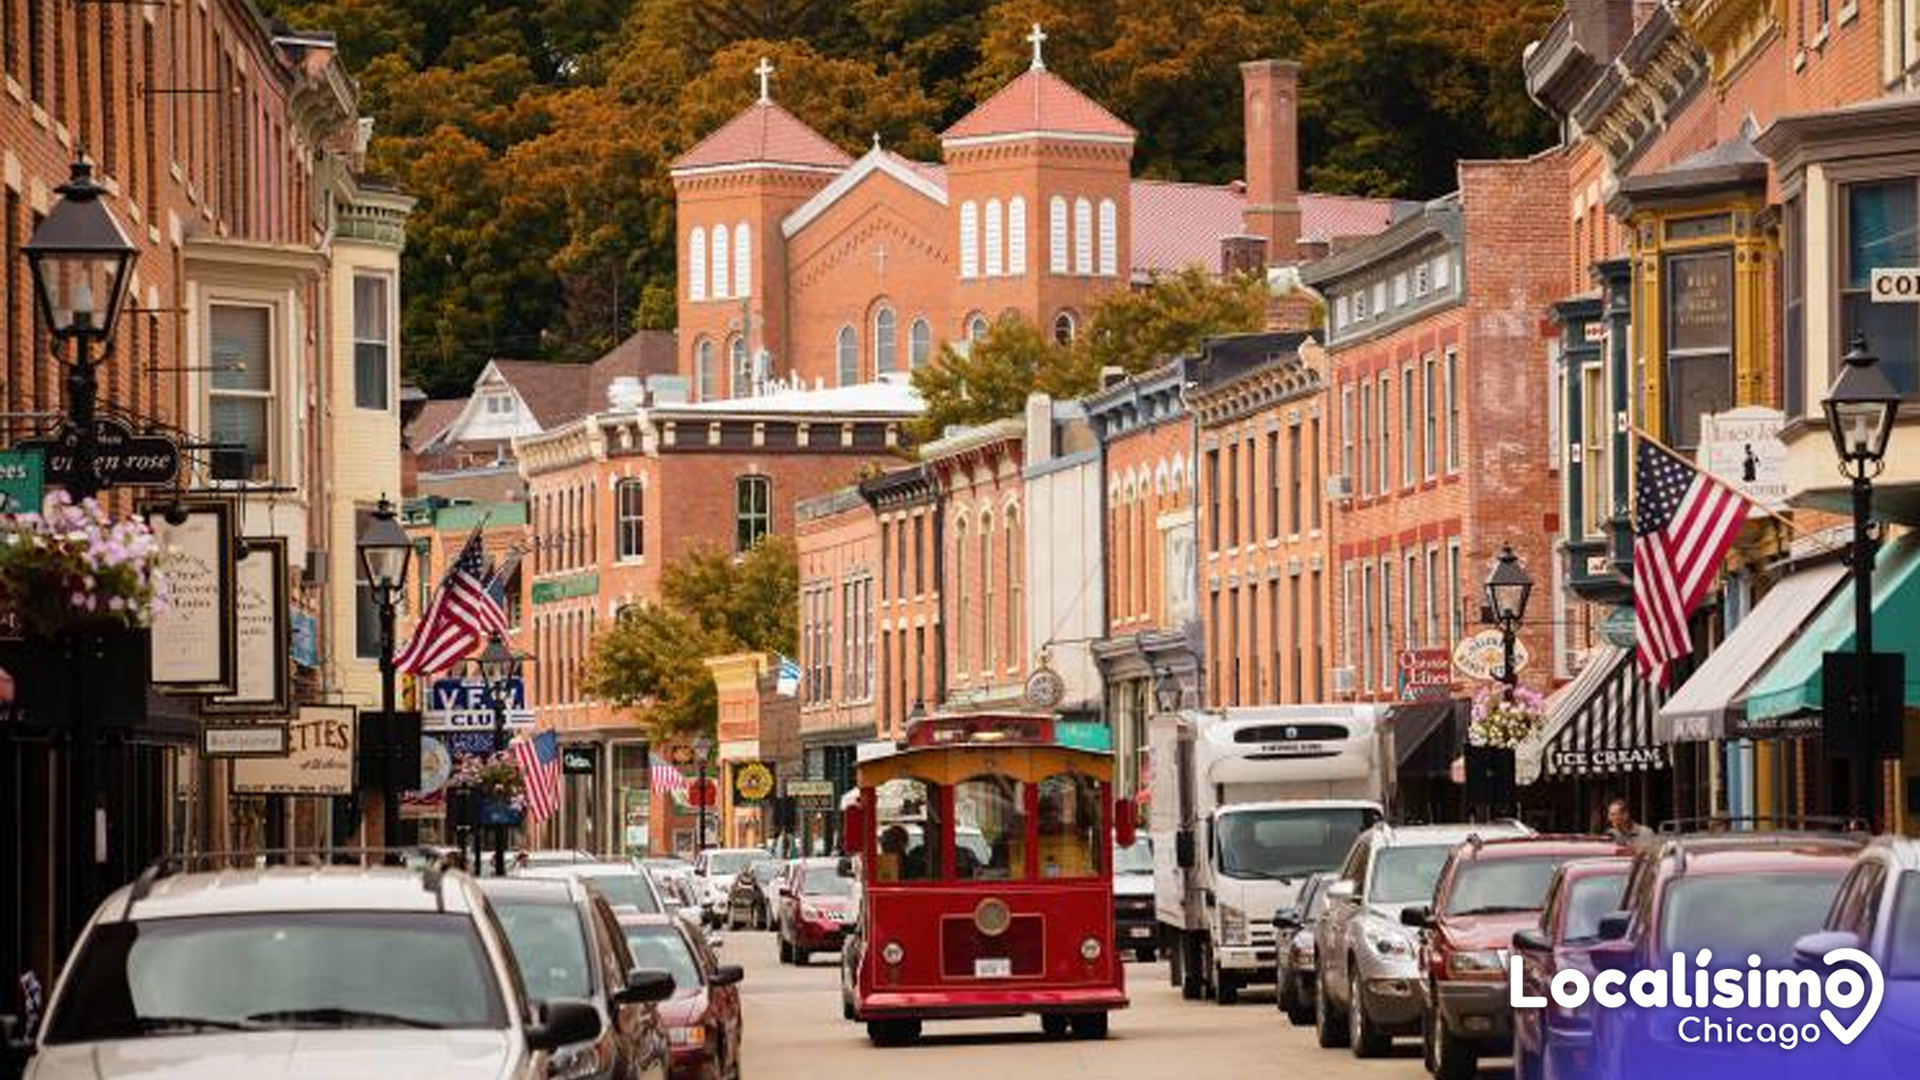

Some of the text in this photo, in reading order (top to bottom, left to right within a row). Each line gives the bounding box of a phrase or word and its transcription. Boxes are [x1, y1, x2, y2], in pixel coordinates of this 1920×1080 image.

[124, 453, 170, 470] rose
[1556, 748, 1660, 766] ICE CREAM
